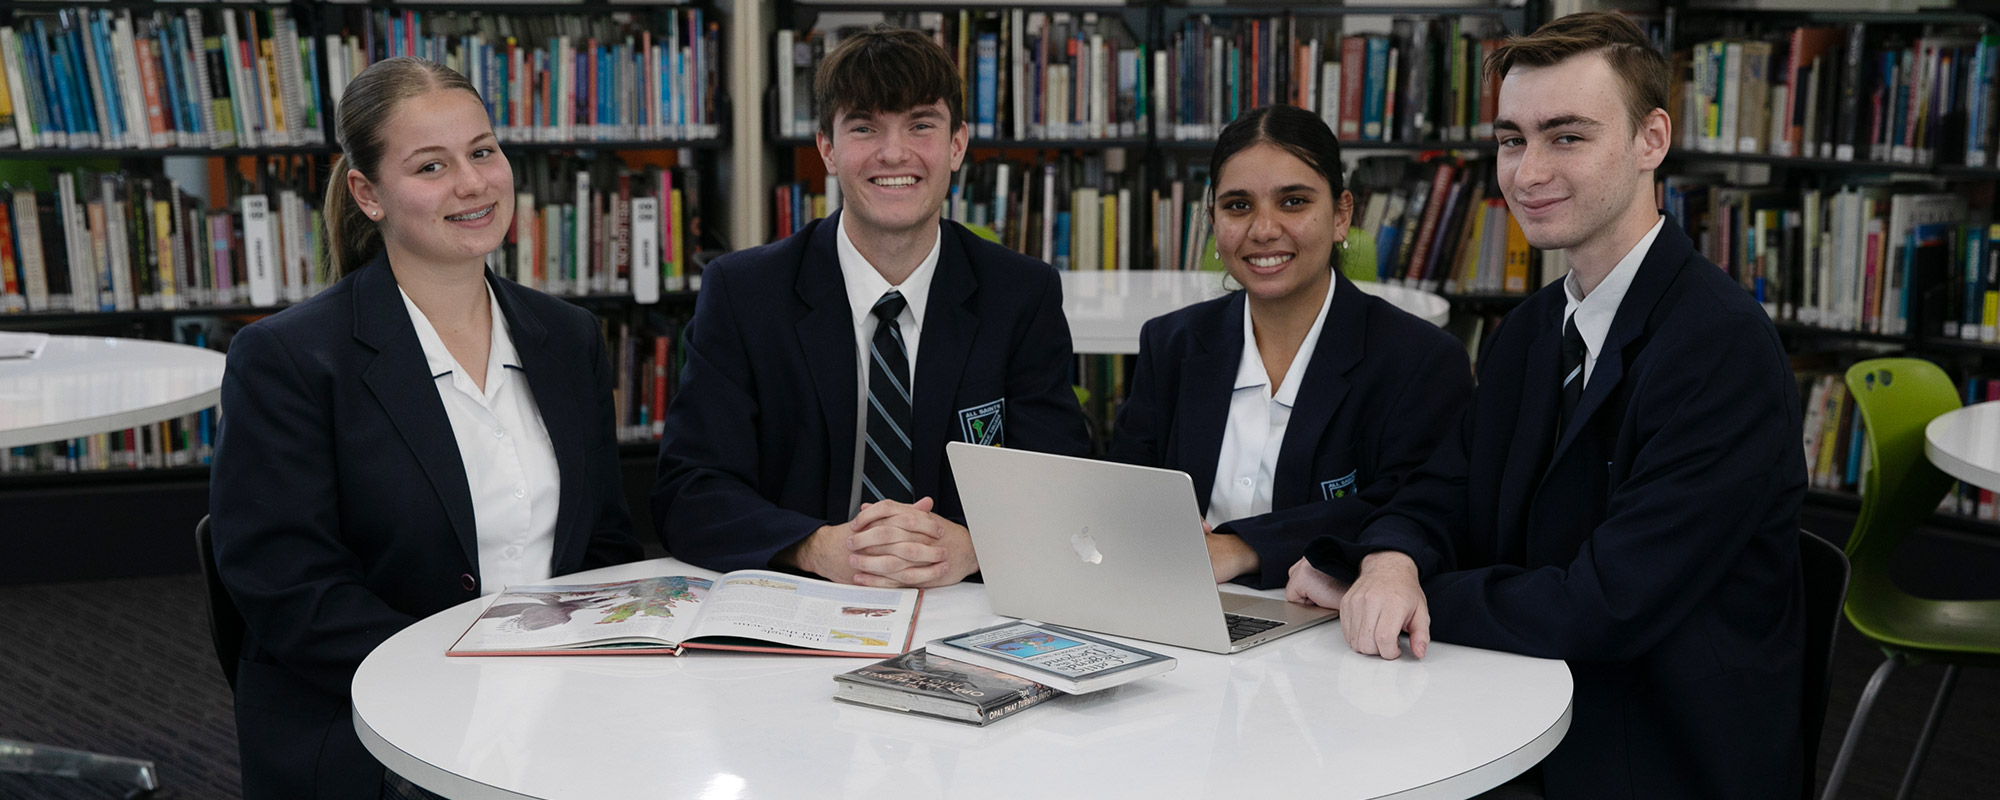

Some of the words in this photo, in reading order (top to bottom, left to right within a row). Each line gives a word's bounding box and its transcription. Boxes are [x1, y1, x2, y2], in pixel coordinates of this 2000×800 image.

[978, 404, 1001, 415] SAINTS
[1040, 648, 1115, 666] Beyond
[1057, 654, 1127, 670] Legends
[948, 686, 984, 697] OPAL
[988, 708, 1004, 720] OPAL
[1004, 702, 1018, 714] THAT
[1018, 695, 1038, 708] TURNED
[1039, 690, 1051, 700] INTO
